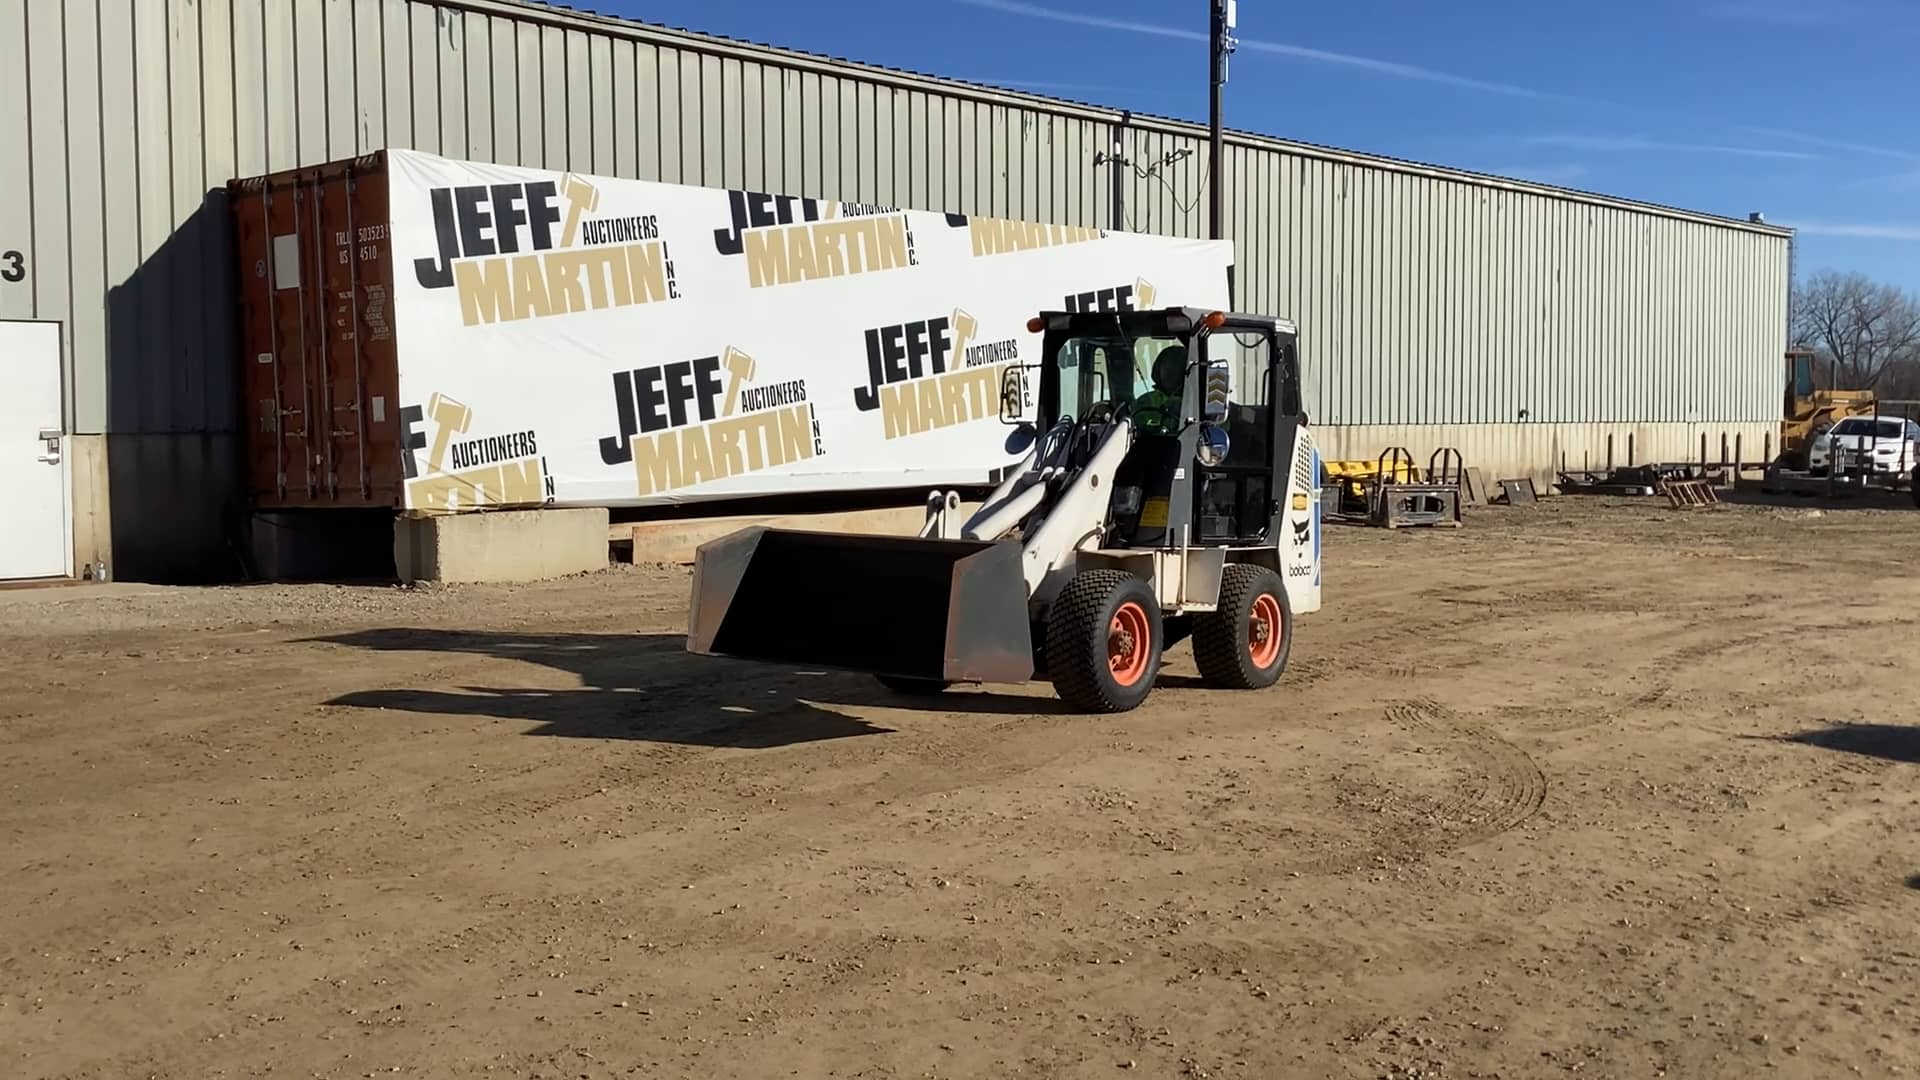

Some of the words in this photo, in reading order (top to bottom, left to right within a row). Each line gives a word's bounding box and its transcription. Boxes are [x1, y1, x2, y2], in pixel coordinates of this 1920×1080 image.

[360, 244, 377, 261] 4510
[414, 181, 560, 289] JEFF
[582, 215, 658, 246] AUCTIONEERS
[744, 215, 907, 288] MARTIN
[1, 250, 25, 282] 3
[454, 243, 667, 327] MARTIN
[854, 317, 952, 412] JEFF
[965, 338, 1018, 368] AUCTIONEERS
[599, 356, 722, 465] JEFF
[741, 379, 807, 413] AUCTIONEERS
[452, 430, 538, 470] AUCTIONEERS
[632, 404, 813, 496] MARTIN
